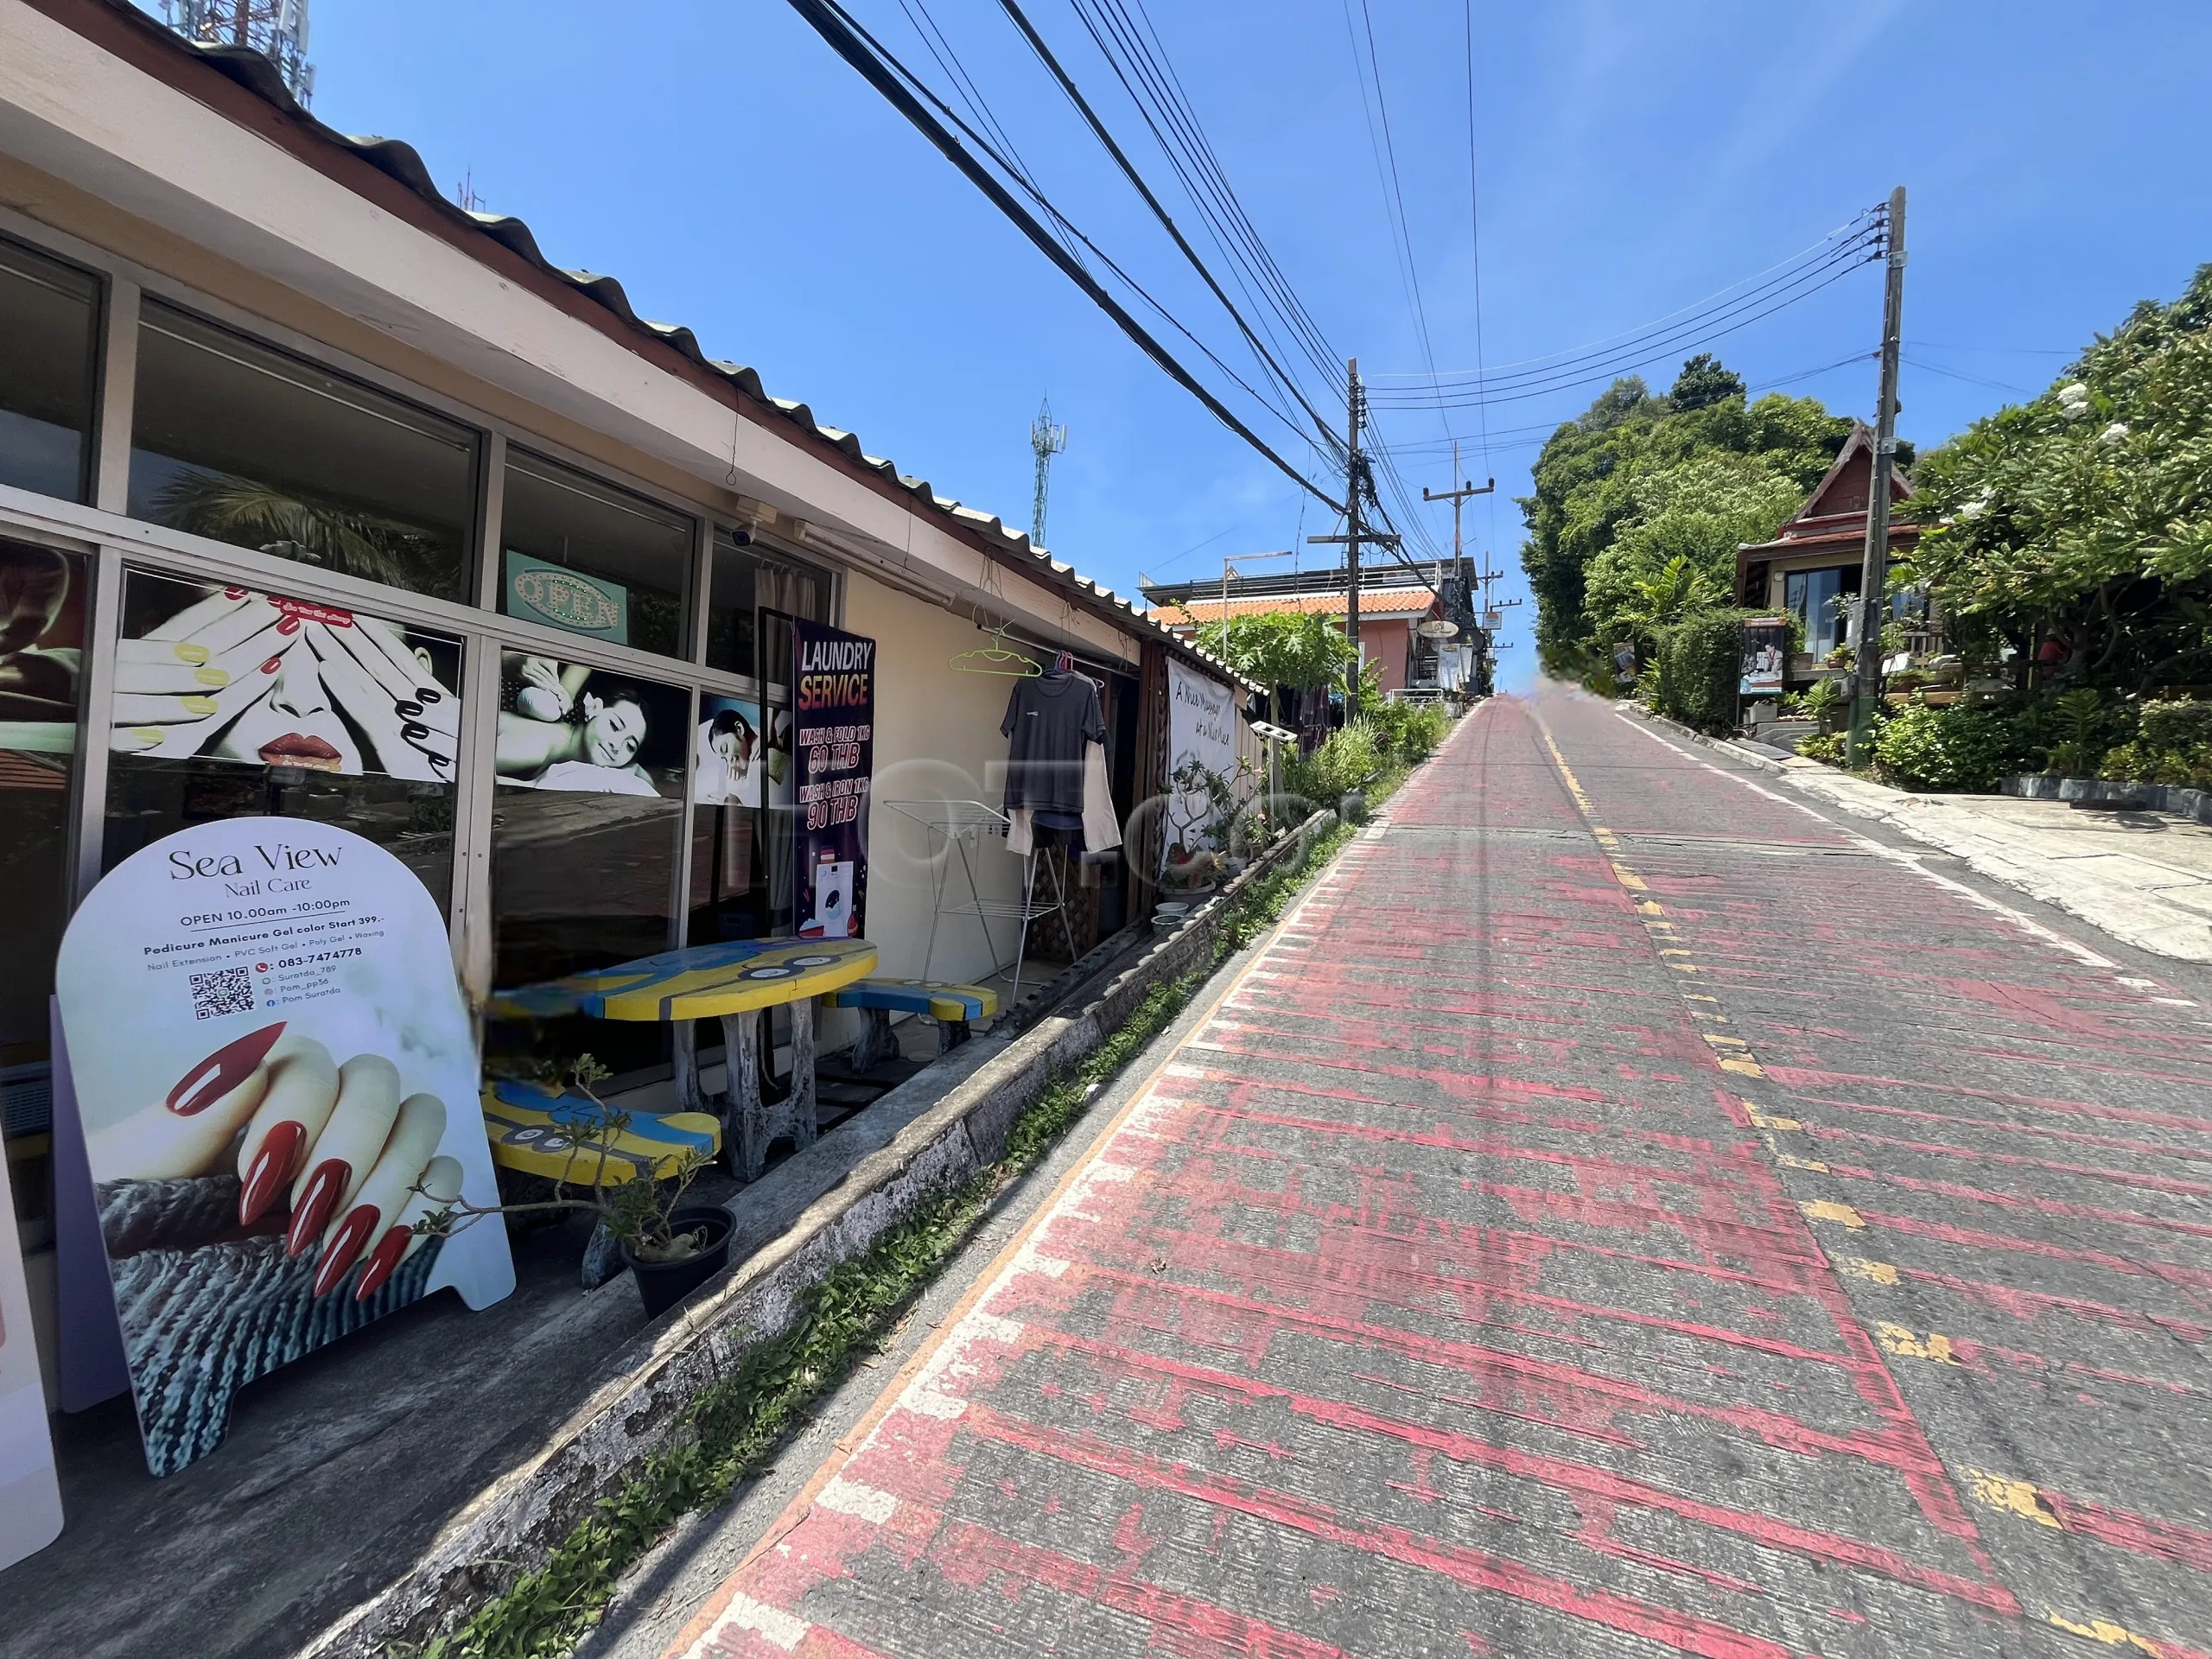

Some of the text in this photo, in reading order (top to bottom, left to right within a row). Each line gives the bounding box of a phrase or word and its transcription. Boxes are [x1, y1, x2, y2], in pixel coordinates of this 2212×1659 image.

[514, 573, 620, 626] OPEN
[801, 641, 872, 671] LAUNDRY
[798, 674, 868, 710] SERVICE
[1176, 681, 1182, 701] A
[799, 725, 870, 746] WASH & FOLD 1KG
[808, 743, 860, 773] 60 THB
[800, 777, 869, 804] WASH & IRON 1KG
[807, 795, 858, 830] 90 THB
[168, 843, 343, 880] Sea View
[225, 878, 312, 898] Nail Care
[181, 912, 222, 926] OPEN
[227, 907, 287, 920] 10.00am
[144, 942, 205, 955] Pedicure
[209, 932, 269, 946] Manicure
[273, 926, 293, 937] Gel
[296, 924, 325, 934] color
[328, 918, 355, 930] Start
[147, 930, 385, 971] Nail Extension PVC Soft Gel Poly Gel Waxing
[278, 947, 362, 969] 083-7474778
[283, 995, 302, 1004] Pom
